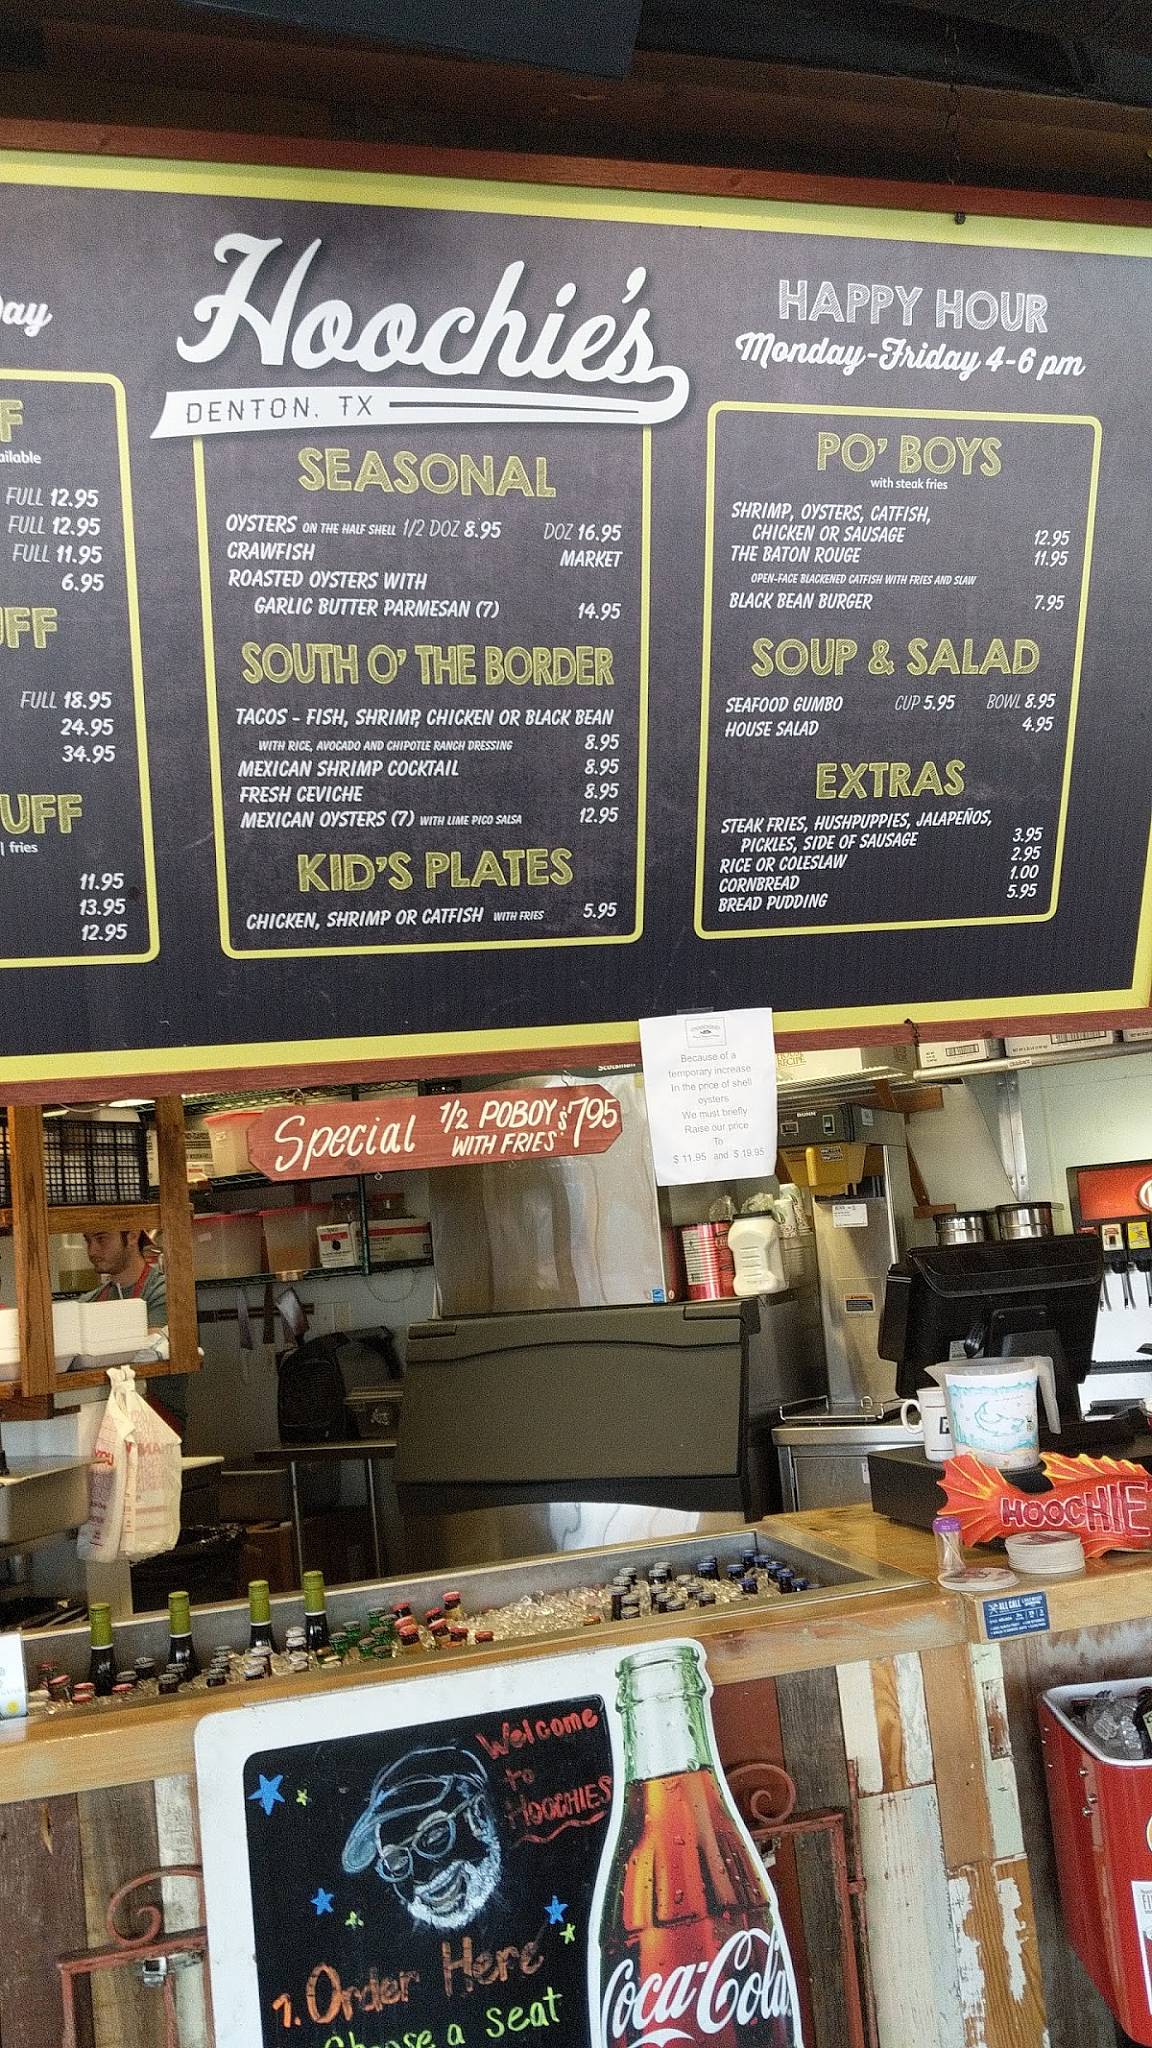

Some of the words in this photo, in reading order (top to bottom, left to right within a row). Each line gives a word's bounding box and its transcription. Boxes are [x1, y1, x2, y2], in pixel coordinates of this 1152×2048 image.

[177, 233, 656, 387] Hoochie's
[778, 280, 924, 326] HAPPY
[936, 288, 1048, 334] HOUR
[735, 331, 981, 382] Monday-Friday
[985, 347, 1037, 374] 4-6
[1037, 352, 1085, 380] pm
[339, 396, 373, 416] TX
[818, 432, 888, 472] PO'
[898, 434, 1002, 476] BOYS
[298, 446, 556, 498] SEASONAL
[870, 476, 894, 488] with
[896, 478, 924, 488] steak
[926, 478, 948, 490] fries
[6, 486, 44, 506] FULL
[50, 488, 98, 508] 12.95
[732, 502, 794, 522] SHRIMP,
[800, 504, 864, 524] OYSTERS,
[870, 506, 930, 524] CATFISH,
[226, 514, 298, 534] OYSTERS
[302, 522, 318, 534] ON
[320, 522, 340, 534] THE
[342, 524, 366, 534] HALF
[368, 524, 396, 536] SHELL
[402, 518, 426, 538] 1/2
[430, 520, 460, 538] DOZ
[464, 520, 502, 540] 8.95
[544, 522, 574, 540] DOZ
[578, 524, 622, 542] 16.95
[1034, 530, 1070, 546] 12.95
[226, 542, 316, 560] CRAWFISH
[560, 550, 624, 568] MARKET
[732, 544, 758, 562] THE
[762, 546, 810, 562] BATON
[814, 546, 862, 564] ROUGE
[62, 572, 104, 592] 6.95
[750, 572, 798, 584] OPEN-FACE
[800, 574, 846, 584] BLACKENED
[848, 574, 884, 584] CATFISH
[884, 574, 908, 584] WITH
[908, 574, 934, 584] FRIES
[934, 576, 952, 584] AND
[954, 576, 976, 586] SLAW
[242, 642, 358, 684] SOUTH
[368, 644, 406, 684] O'
[414, 644, 476, 686] THE
[484, 646, 614, 686] BORDER
[752, 638, 858, 676] SOUP
[868, 640, 894, 676] &
[906, 638, 1040, 676] SALAD
[20, 690, 56, 708] FULL
[64, 690, 112, 710] 18.95
[726, 696, 790, 712] SEAFOOD
[792, 696, 844, 712] GUMBO
[894, 694, 920, 710] CUP
[924, 694, 956, 712] 5.95
[986, 694, 1022, 710] BOWL
[1024, 694, 1056, 710] 8.95
[236, 708, 288, 724] TACOS
[306, 708, 348, 728] FISH,
[356, 708, 422, 728] SHRIMP,
[426, 708, 494, 726] CHICKEN
[498, 710, 520, 726] OR
[526, 708, 572, 726] BLACK
[574, 708, 614, 726] BEAN
[724, 720, 772, 738] HOUSE
[776, 720, 820, 736] SALAD
[1022, 716, 1054, 732] 4.95
[258, 740, 286, 750] WITH
[288, 740, 312, 752] RICE,
[316, 740, 362, 752] AVOCADO
[364, 740, 384, 750] AND
[386, 740, 432, 750] CHIPOTLE
[434, 740, 466, 750] RANCH
[468, 740, 512, 752] DRESSING
[816, 760, 966, 800] EXTRAS
[240, 812, 314, 828] MEXICAN
[320, 810, 386, 828] OYSTERS
[390, 810, 414, 826] (7)
[420, 816, 446, 826] WITH
[446, 816, 470, 826] LIME
[472, 814, 494, 824] PICO
[496, 814, 522, 824] SALSA
[580, 806, 618, 824] 12.95
[720, 818, 764, 834] STEAK
[766, 816, 808, 832] FRIES,
[814, 812, 910, 830] HUSHPUPPIES,
[916, 808, 992, 826] JALAPEÑOS,
[1012, 826, 1044, 842] 3.95
[8, 840, 38, 852] fries
[298, 852, 412, 892] KID'S
[426, 848, 574, 888] PLATES
[718, 874, 800, 892] CORNBREAD
[1006, 882, 1038, 898] 5.95
[718, 896, 762, 912] BREAD
[766, 892, 828, 910] PUDDING
[246, 912, 320, 930] CHICKEN,
[326, 910, 392, 928] SHRIMP
[396, 908, 418, 926] OR
[422, 906, 484, 924] CATFISH
[494, 912, 518, 922] WITH
[518, 910, 544, 920] FRIES
[582, 902, 618, 918] 5.95
[681, 1054, 718, 1063] Because
[720, 1052, 729, 1060] of
[668, 1068, 712, 1079] temporary
[715, 1066, 751, 1075] increase
[671, 1084, 680, 1092] In
[682, 1082, 696, 1091] the
[699, 1082, 719, 1092] price
[721, 1080, 730, 1088] of
[732, 1079, 752, 1087] shell
[698, 1096, 729, 1104] oysters
[682, 1111, 696, 1119] We
[700, 1110, 720, 1118] must
[722, 1107, 748, 1117] briefly
[274, 1115, 417, 1173] Special
[440, 1100, 469, 1133] 1/2
[479, 1098, 558, 1129] POBOY
[685, 1124, 709, 1134] Raise
[728, 1122, 749, 1132] price
[452, 1133, 498, 1157] WITH
[500, 1131, 558, 1154] FRIES
[673, 1154, 679, 1164] $
[682, 1152, 706, 1163] 11.95
[714, 1152, 728, 1160] and
[734, 1149, 739, 1158] $
[742, 1148, 764, 1157] 19.95
[475, 1708, 599, 1760] Welcome
[506, 1768, 535, 1791] to
[273, 1993, 300, 2028] 1.
[306, 1963, 419, 2024] Order
[442, 1937, 544, 1996] Here
[602, 1927, 791, 2046] Coca-Cola
[449, 2024, 465, 2045] a
[486, 1986, 562, 2038] seat
